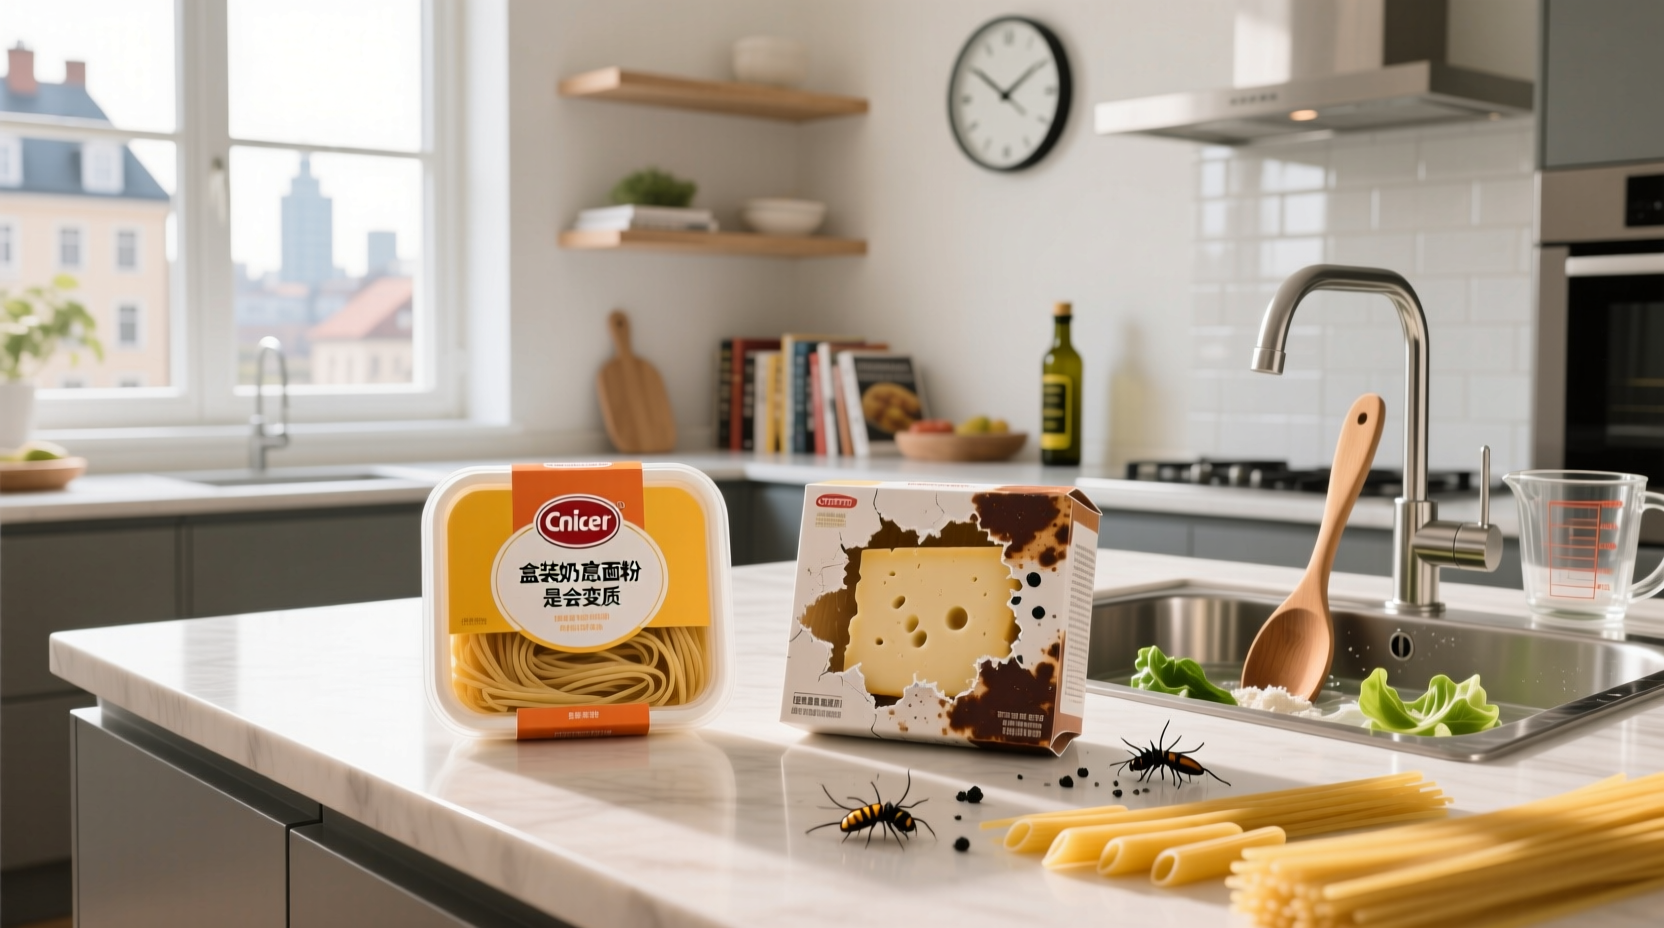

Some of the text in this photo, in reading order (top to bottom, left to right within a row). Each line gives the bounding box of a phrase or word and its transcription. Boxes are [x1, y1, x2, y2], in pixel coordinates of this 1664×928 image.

[545, 509, 612, 532] Cnicer
[543, 586, 621, 608] 是会变质
